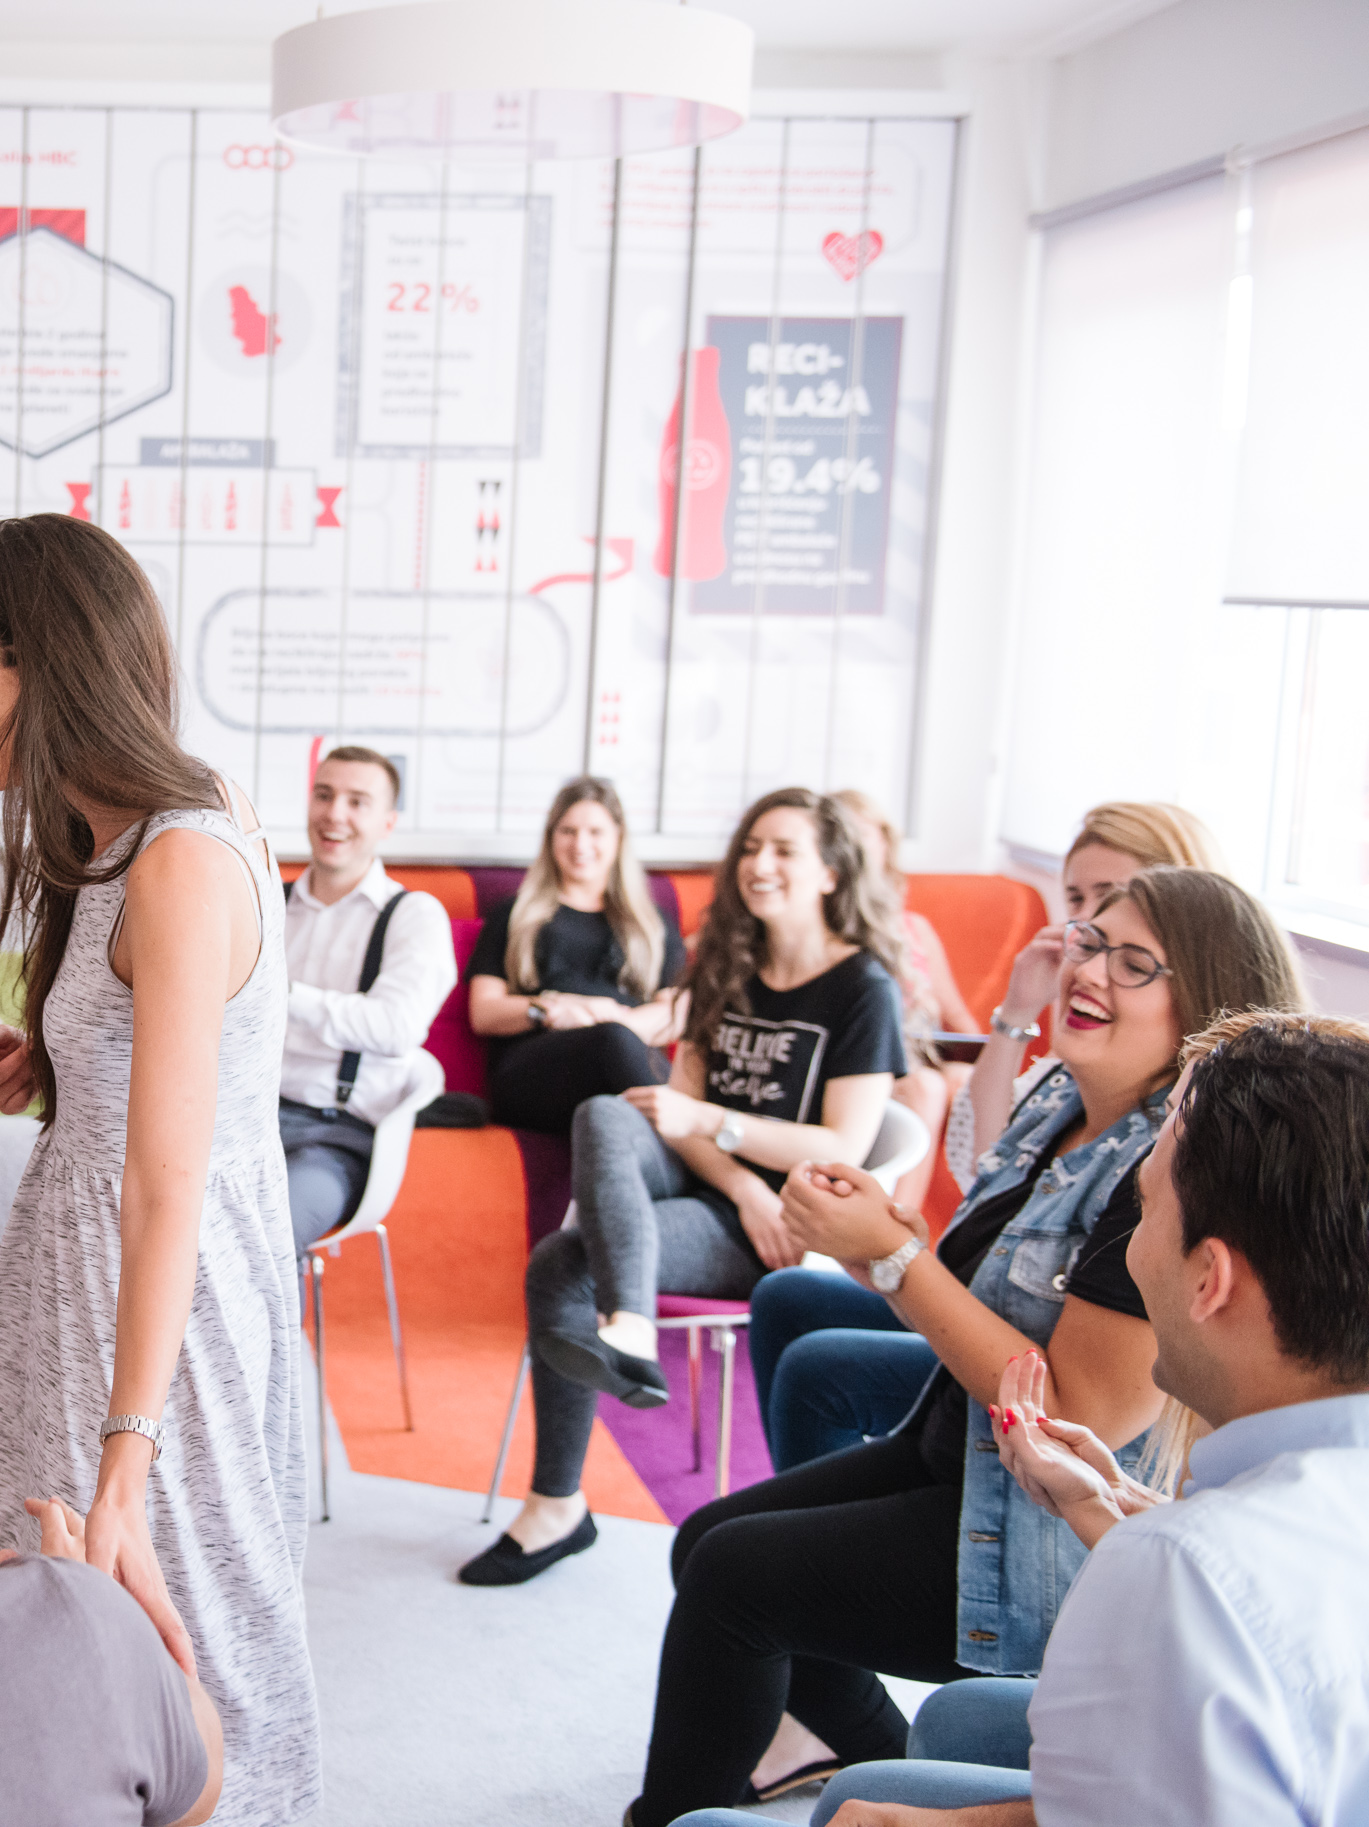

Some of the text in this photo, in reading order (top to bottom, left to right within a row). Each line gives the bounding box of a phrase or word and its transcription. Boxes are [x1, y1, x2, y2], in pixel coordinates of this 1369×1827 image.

[39, 149, 79, 167] HBC
[387, 281, 481, 314] 22%
[747, 341, 845, 376] RECI-
[744, 380, 872, 418] KLAŽA
[739, 456, 881, 495] 19.4%
